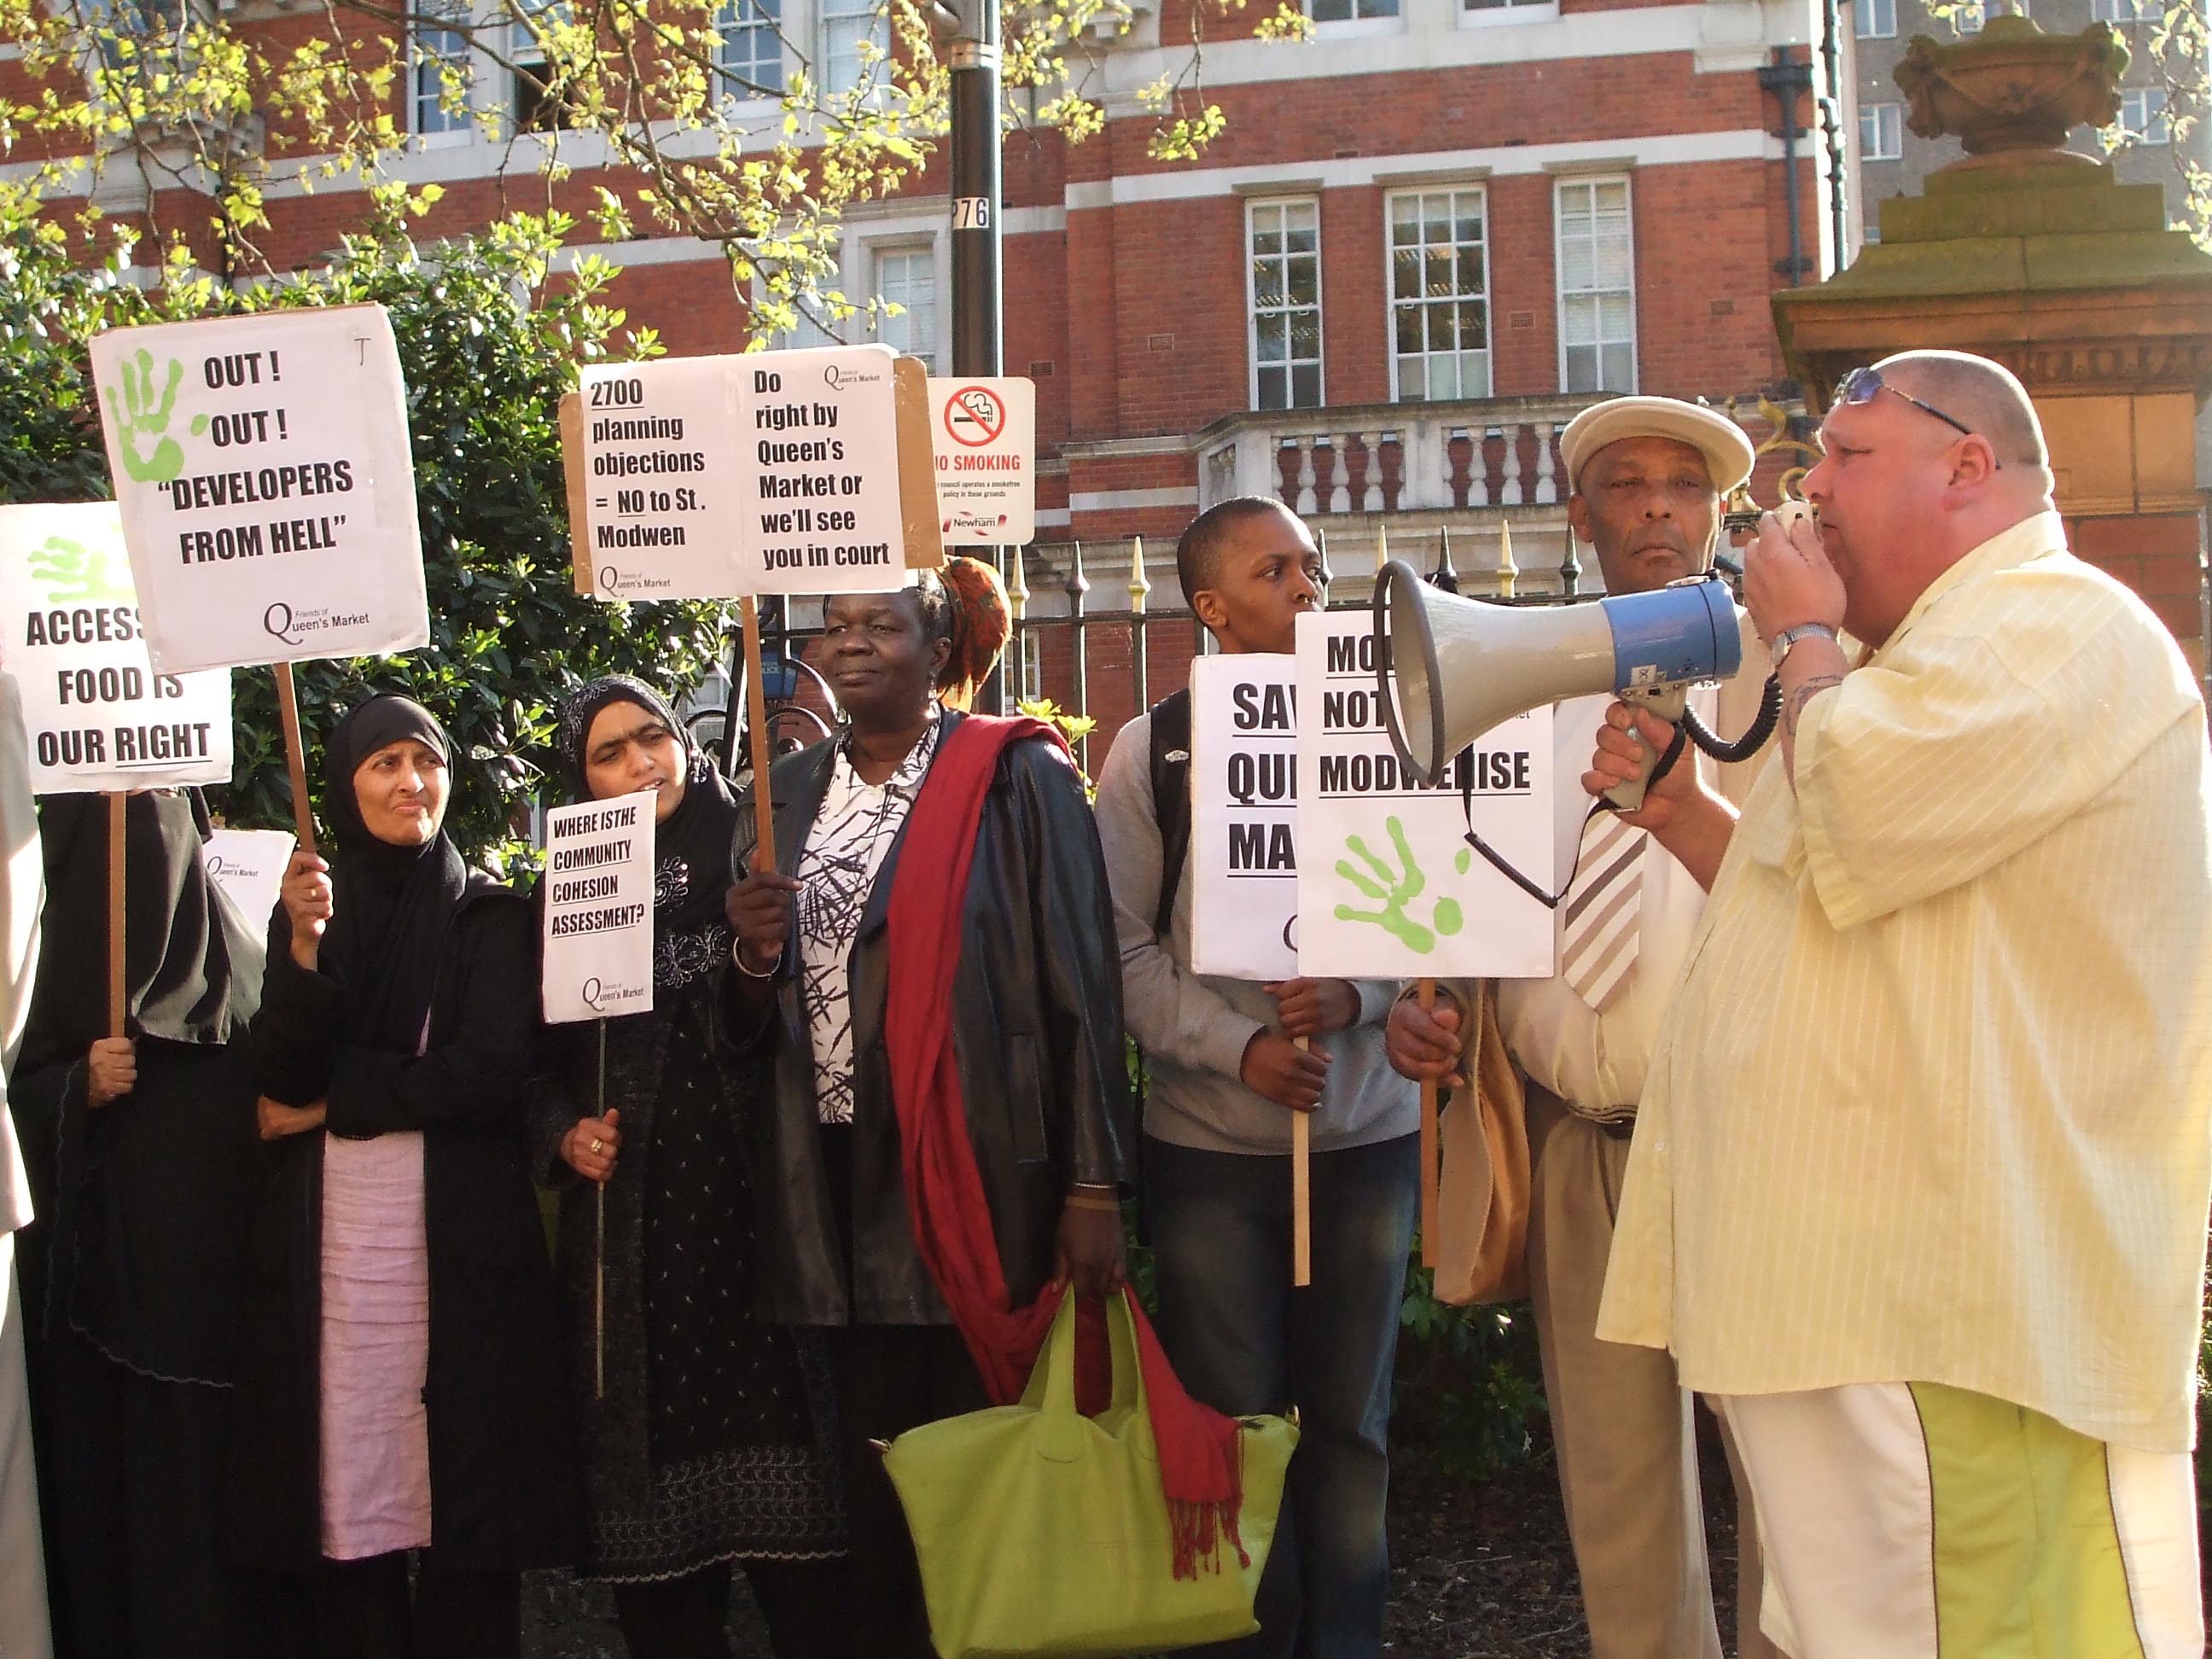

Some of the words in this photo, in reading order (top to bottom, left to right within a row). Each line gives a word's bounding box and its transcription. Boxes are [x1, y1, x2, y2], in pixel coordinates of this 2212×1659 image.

[204, 352, 262, 389] OUT
[754, 370, 782, 393] Do
[590, 378, 643, 406] 2700
[211, 410, 269, 447] OUT
[593, 416, 684, 444] planning
[756, 404, 810, 431] right
[813, 402, 838, 428] by
[594, 450, 705, 477] objections
[758, 437, 844, 466] Queen's
[954, 454, 1021, 471] SMOKING
[759, 474, 837, 499] Market
[841, 474, 863, 495] or
[617, 489, 645, 514] NO
[649, 490, 671, 512] to
[761, 509, 812, 533] we'll
[817, 510, 856, 531] see
[953, 518, 996, 527] Newham
[179, 524, 264, 565] FROM
[597, 524, 686, 549] Modwen
[763, 547, 803, 571] you
[807, 544, 829, 567] in
[834, 543, 890, 566] court
[643, 579, 671, 588] Market
[264, 602, 329, 645] Queen's
[331, 613, 370, 628] Market
[58, 667, 143, 704] FOOD
[154, 674, 183, 699] IS
[1233, 683, 1297, 731] SA
[38, 729, 106, 766] OUR
[114, 723, 211, 762] RIGHT
[554, 812, 598, 839] WHERE
[554, 839, 632, 871] COMMUNITY
[552, 875, 619, 903] COHESION
[551, 903, 645, 935] ASSESSMENT?
